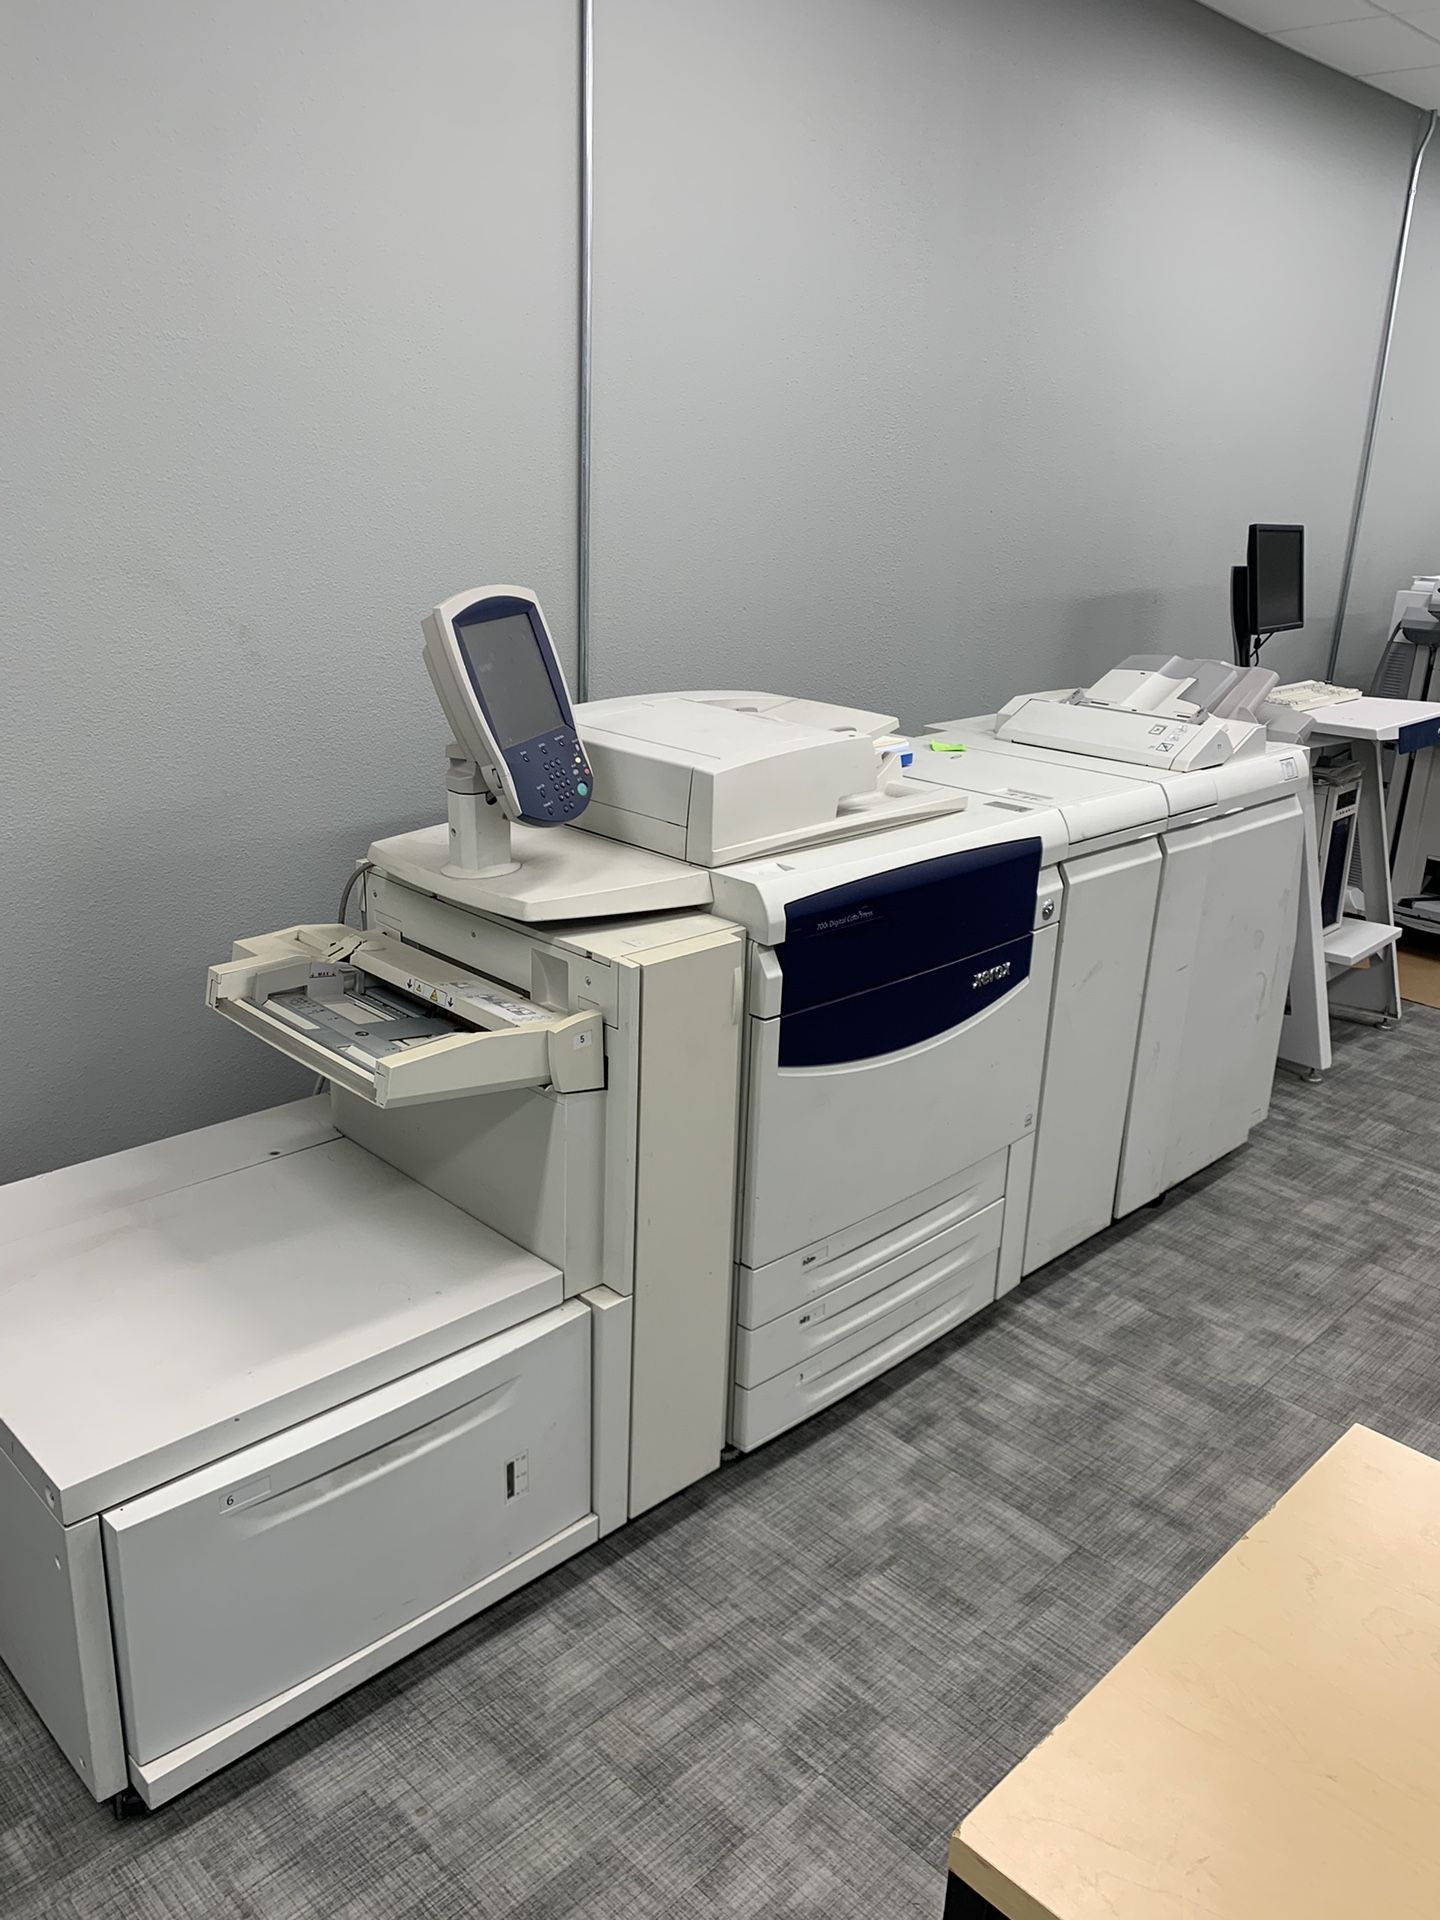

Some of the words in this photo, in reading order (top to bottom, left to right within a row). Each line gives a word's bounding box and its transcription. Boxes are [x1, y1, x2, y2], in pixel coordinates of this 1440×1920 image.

[829, 916, 847, 928] Digital
[847, 914, 860, 923] Color
[973, 961, 1011, 989] xerox
[579, 1034, 585, 1044] 5
[226, 1494, 234, 1506] 6
